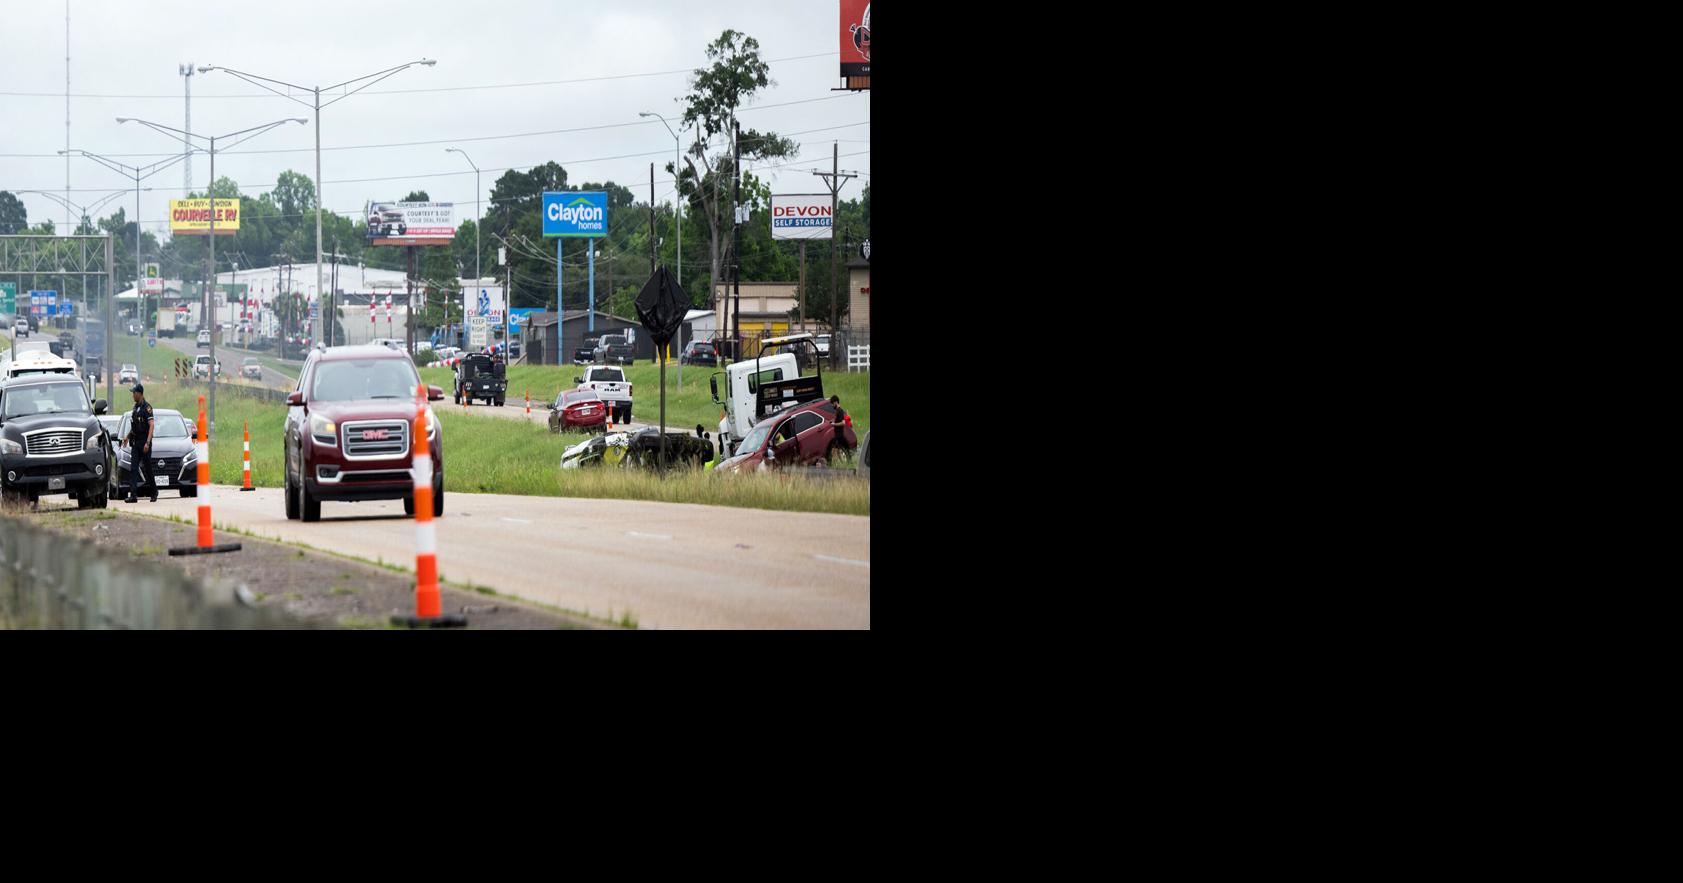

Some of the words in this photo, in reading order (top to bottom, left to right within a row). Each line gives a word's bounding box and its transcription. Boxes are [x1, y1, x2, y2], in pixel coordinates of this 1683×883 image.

[225, 208, 237, 221] RV
[548, 203, 602, 224] Clayton
[774, 206, 831, 216] DEVON
[578, 221, 602, 229] homes
[362, 430, 389, 440] GMC
